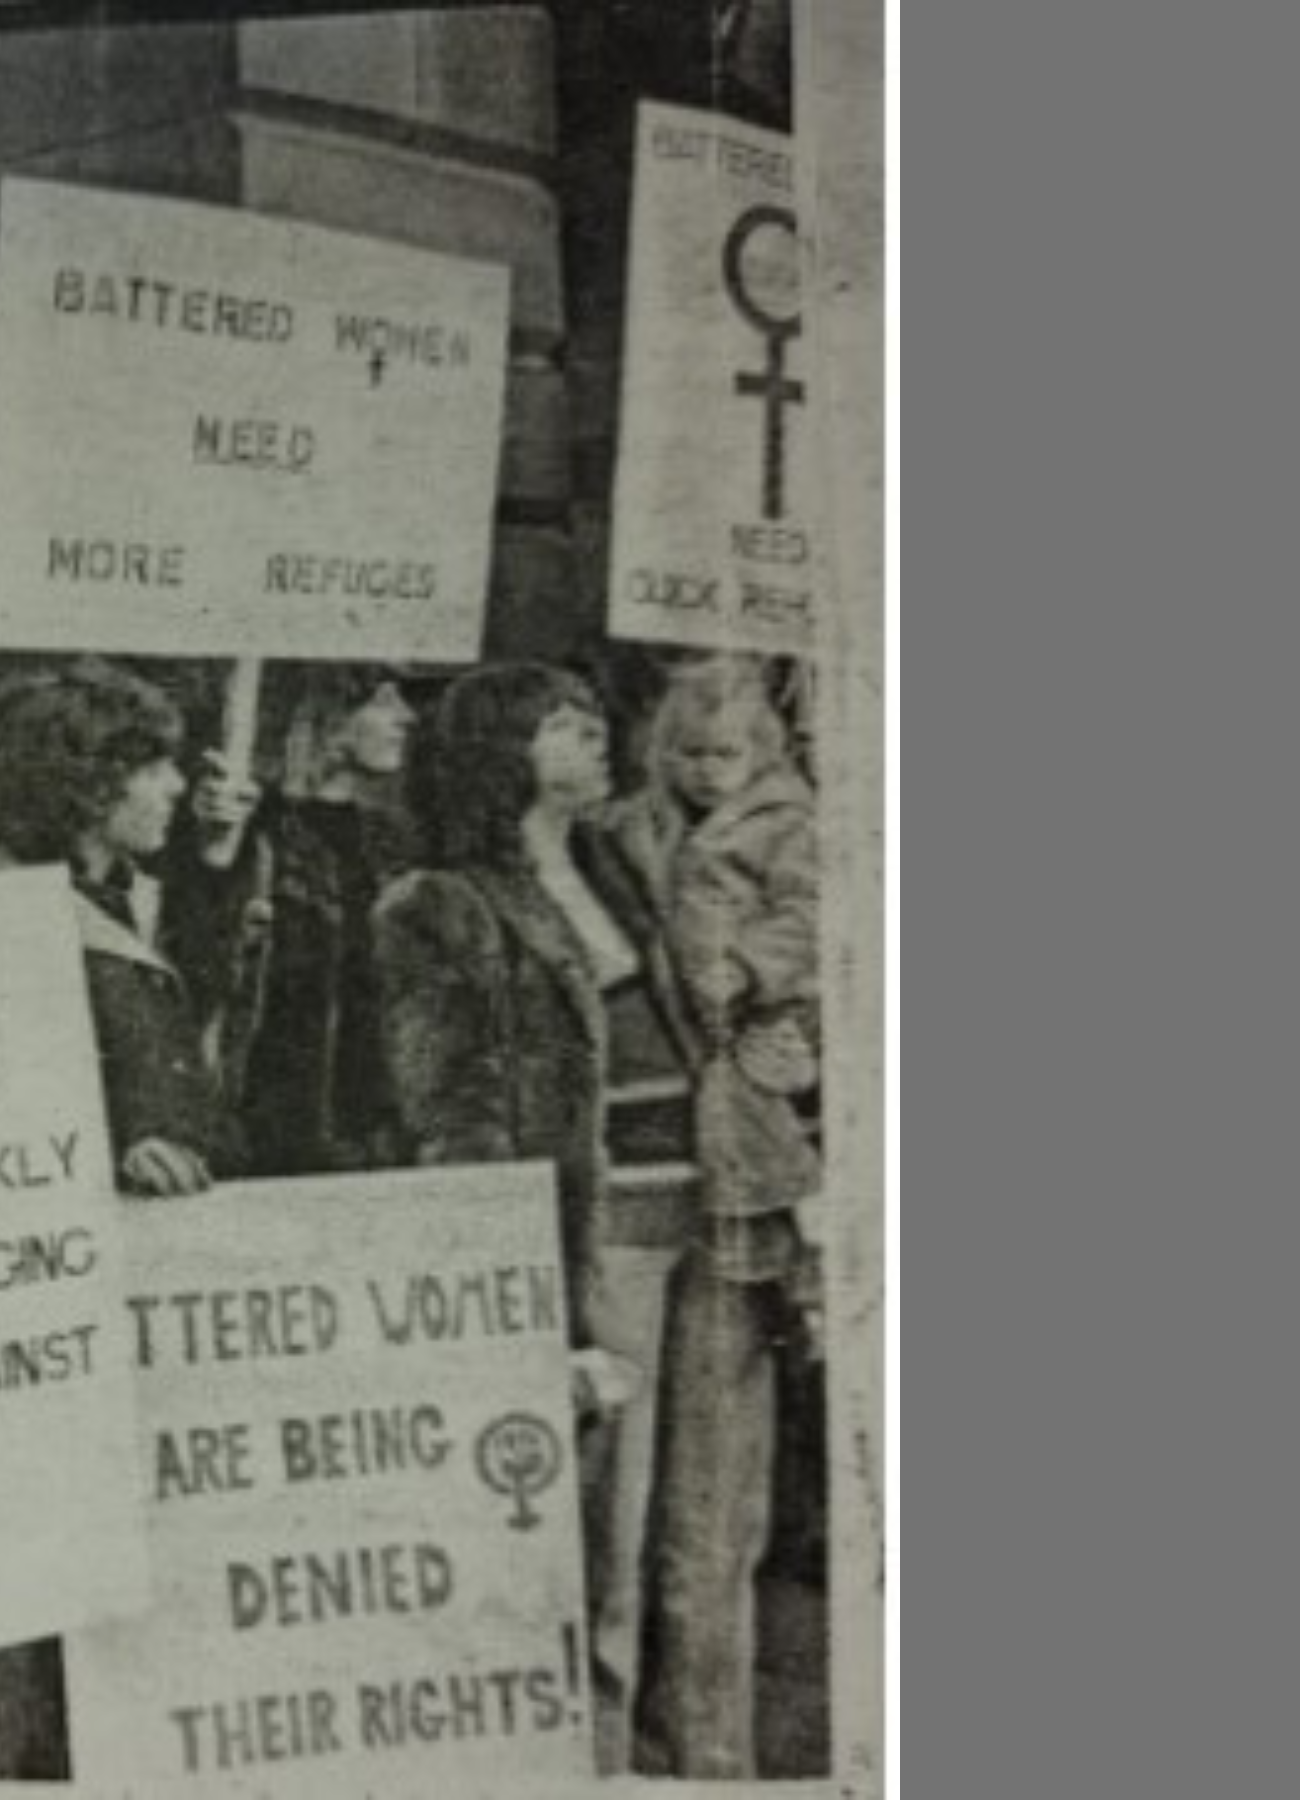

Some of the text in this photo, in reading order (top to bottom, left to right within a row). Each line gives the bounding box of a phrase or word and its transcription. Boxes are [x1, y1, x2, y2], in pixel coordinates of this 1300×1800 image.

[653, 126, 795, 192] BATTERE
[53, 267, 472, 369] BATTERED WOMEN
[192, 414, 317, 473] NEED
[47, 537, 438, 600] MORE REFUGES
[125, 1264, 560, 1368] TTERED WOMEN
[155, 1402, 454, 1501] ARE BEING
[227, 1542, 455, 1632] DENIED
[170, 1619, 585, 1773] THEIR RIGHTS!
